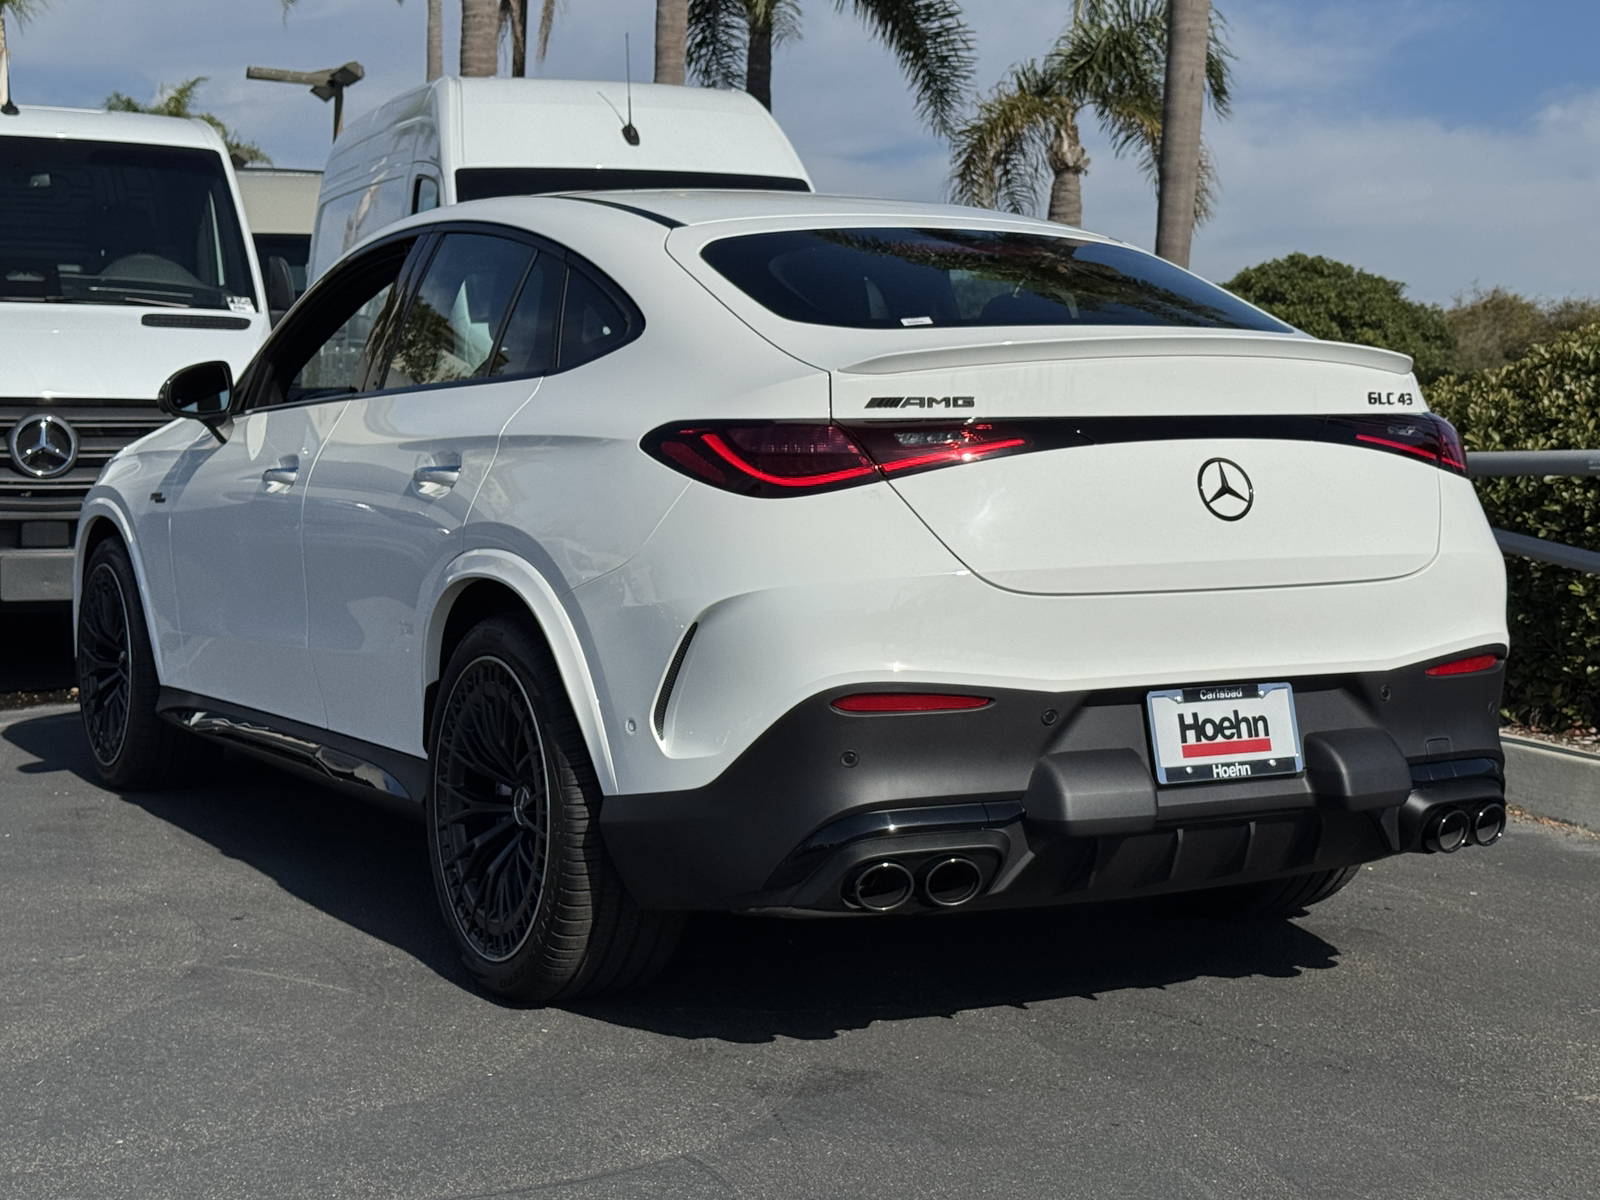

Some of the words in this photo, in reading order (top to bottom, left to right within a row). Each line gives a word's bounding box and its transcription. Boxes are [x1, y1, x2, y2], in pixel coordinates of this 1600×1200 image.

[899, 396, 975, 408] AMG
[1368, 392, 1395, 405] GLC
[1398, 393, 1413, 406] 43
[1199, 687, 1243, 700] Carlsbad
[1177, 709, 1270, 744] Hoehn
[1212, 763, 1251, 778] Hoehn
